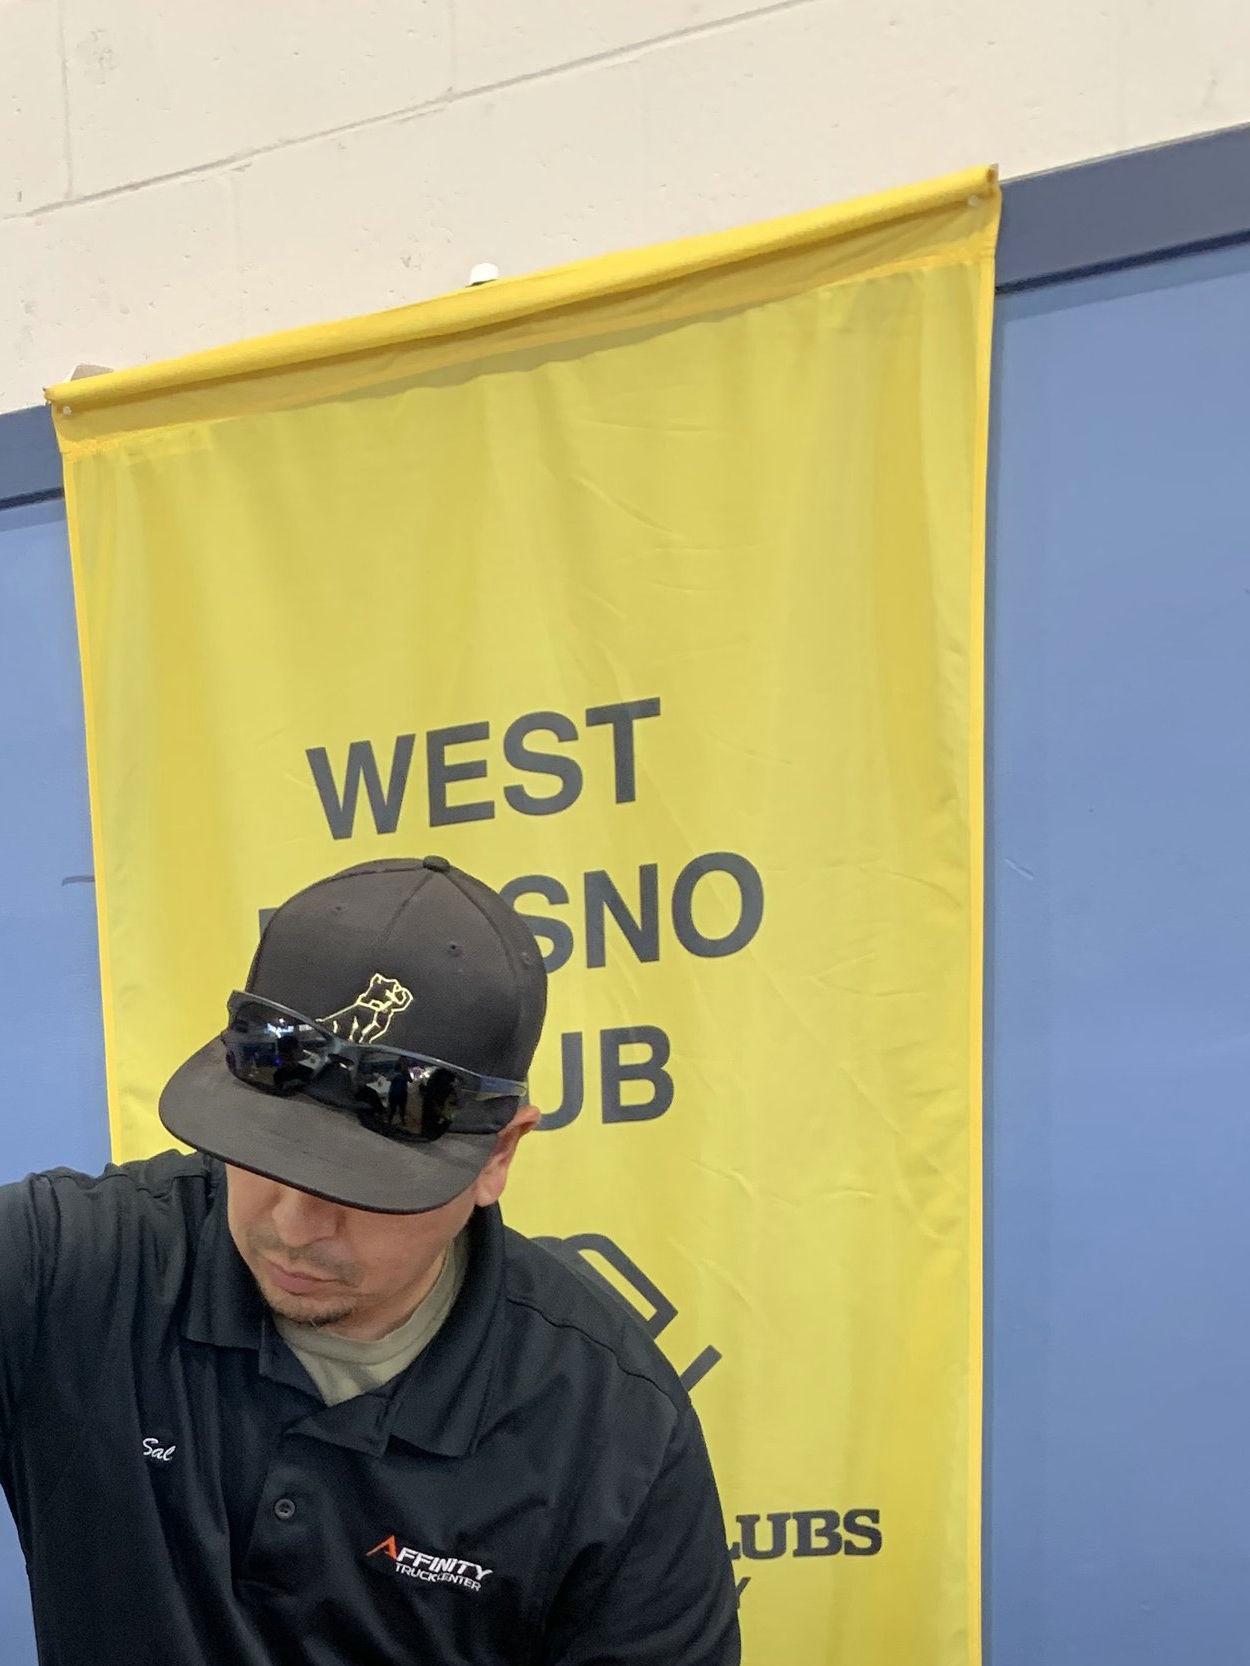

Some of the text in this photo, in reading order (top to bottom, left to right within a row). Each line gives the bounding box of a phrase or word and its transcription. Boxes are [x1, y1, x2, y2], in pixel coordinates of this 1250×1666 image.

[306, 697, 661, 841] WEST
[523, 1024, 675, 1132] UB
[143, 1437, 176, 1461] Sal
[366, 1535, 493, 1581] AFFINITY
